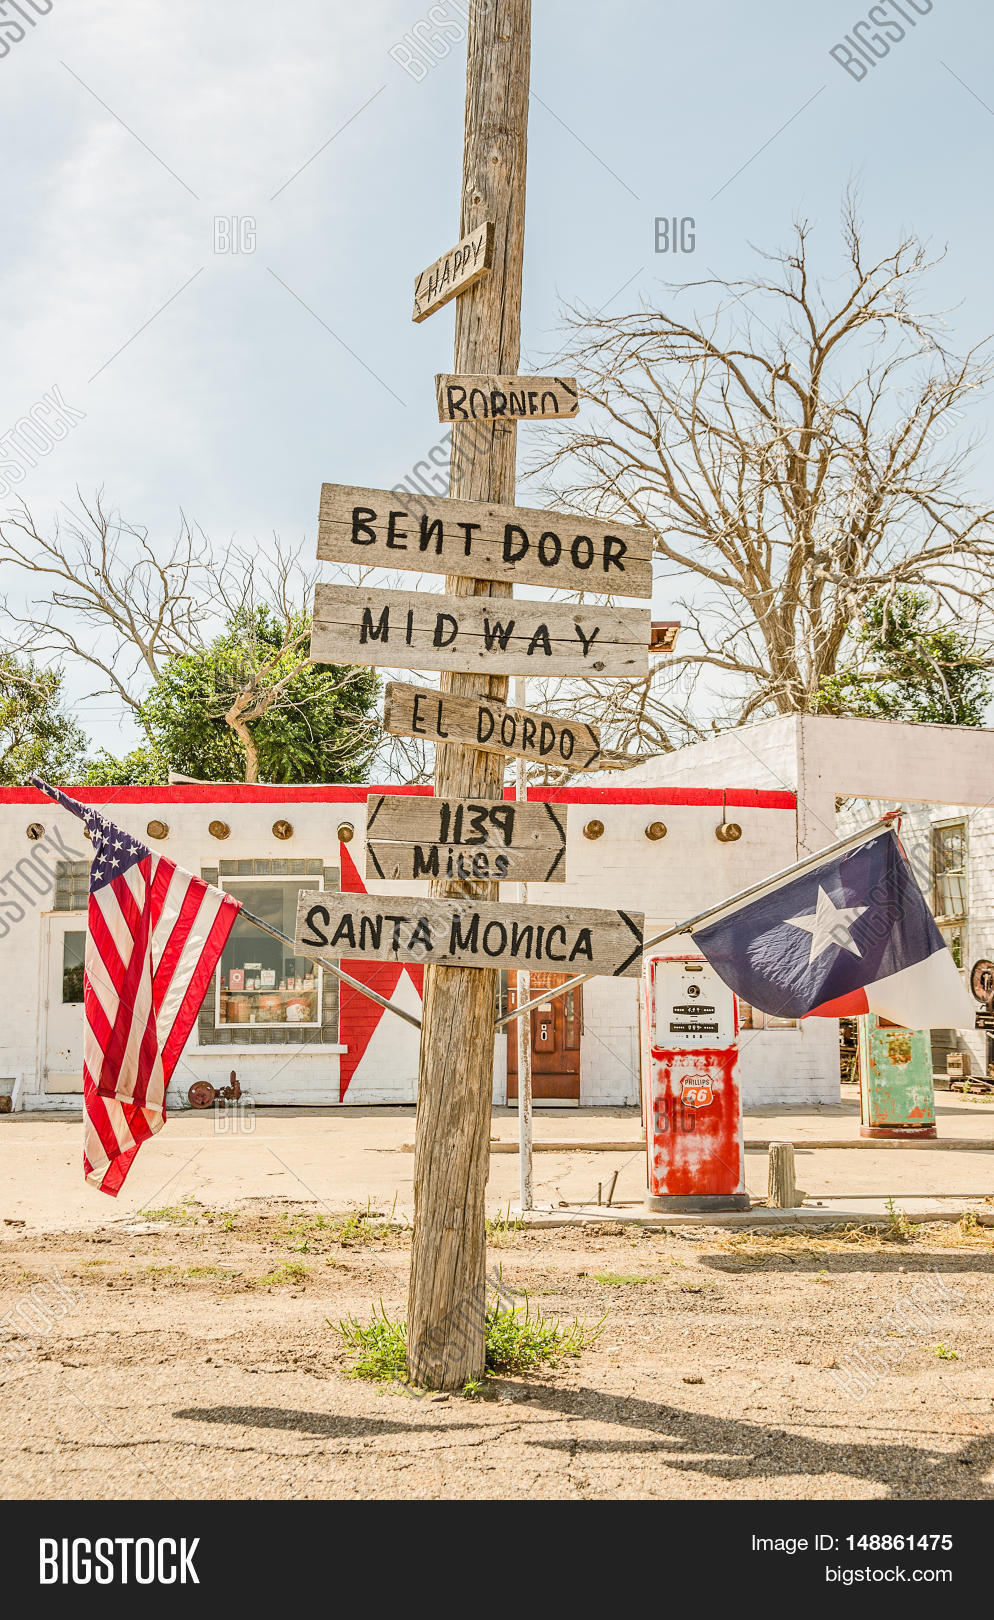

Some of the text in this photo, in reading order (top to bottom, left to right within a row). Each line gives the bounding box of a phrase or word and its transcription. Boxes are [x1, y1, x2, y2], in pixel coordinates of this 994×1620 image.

[428, 235, 482, 303] HAPPY
[351, 507, 628, 573] BENT DOOR
[359, 605, 599, 657] MIDWAY
[412, 694, 575, 761] EL DORDO
[439, 802, 515, 847] 1139
[302, 905, 594, 963] SANTA MONICA
[686, 1089, 708, 1102] 66
